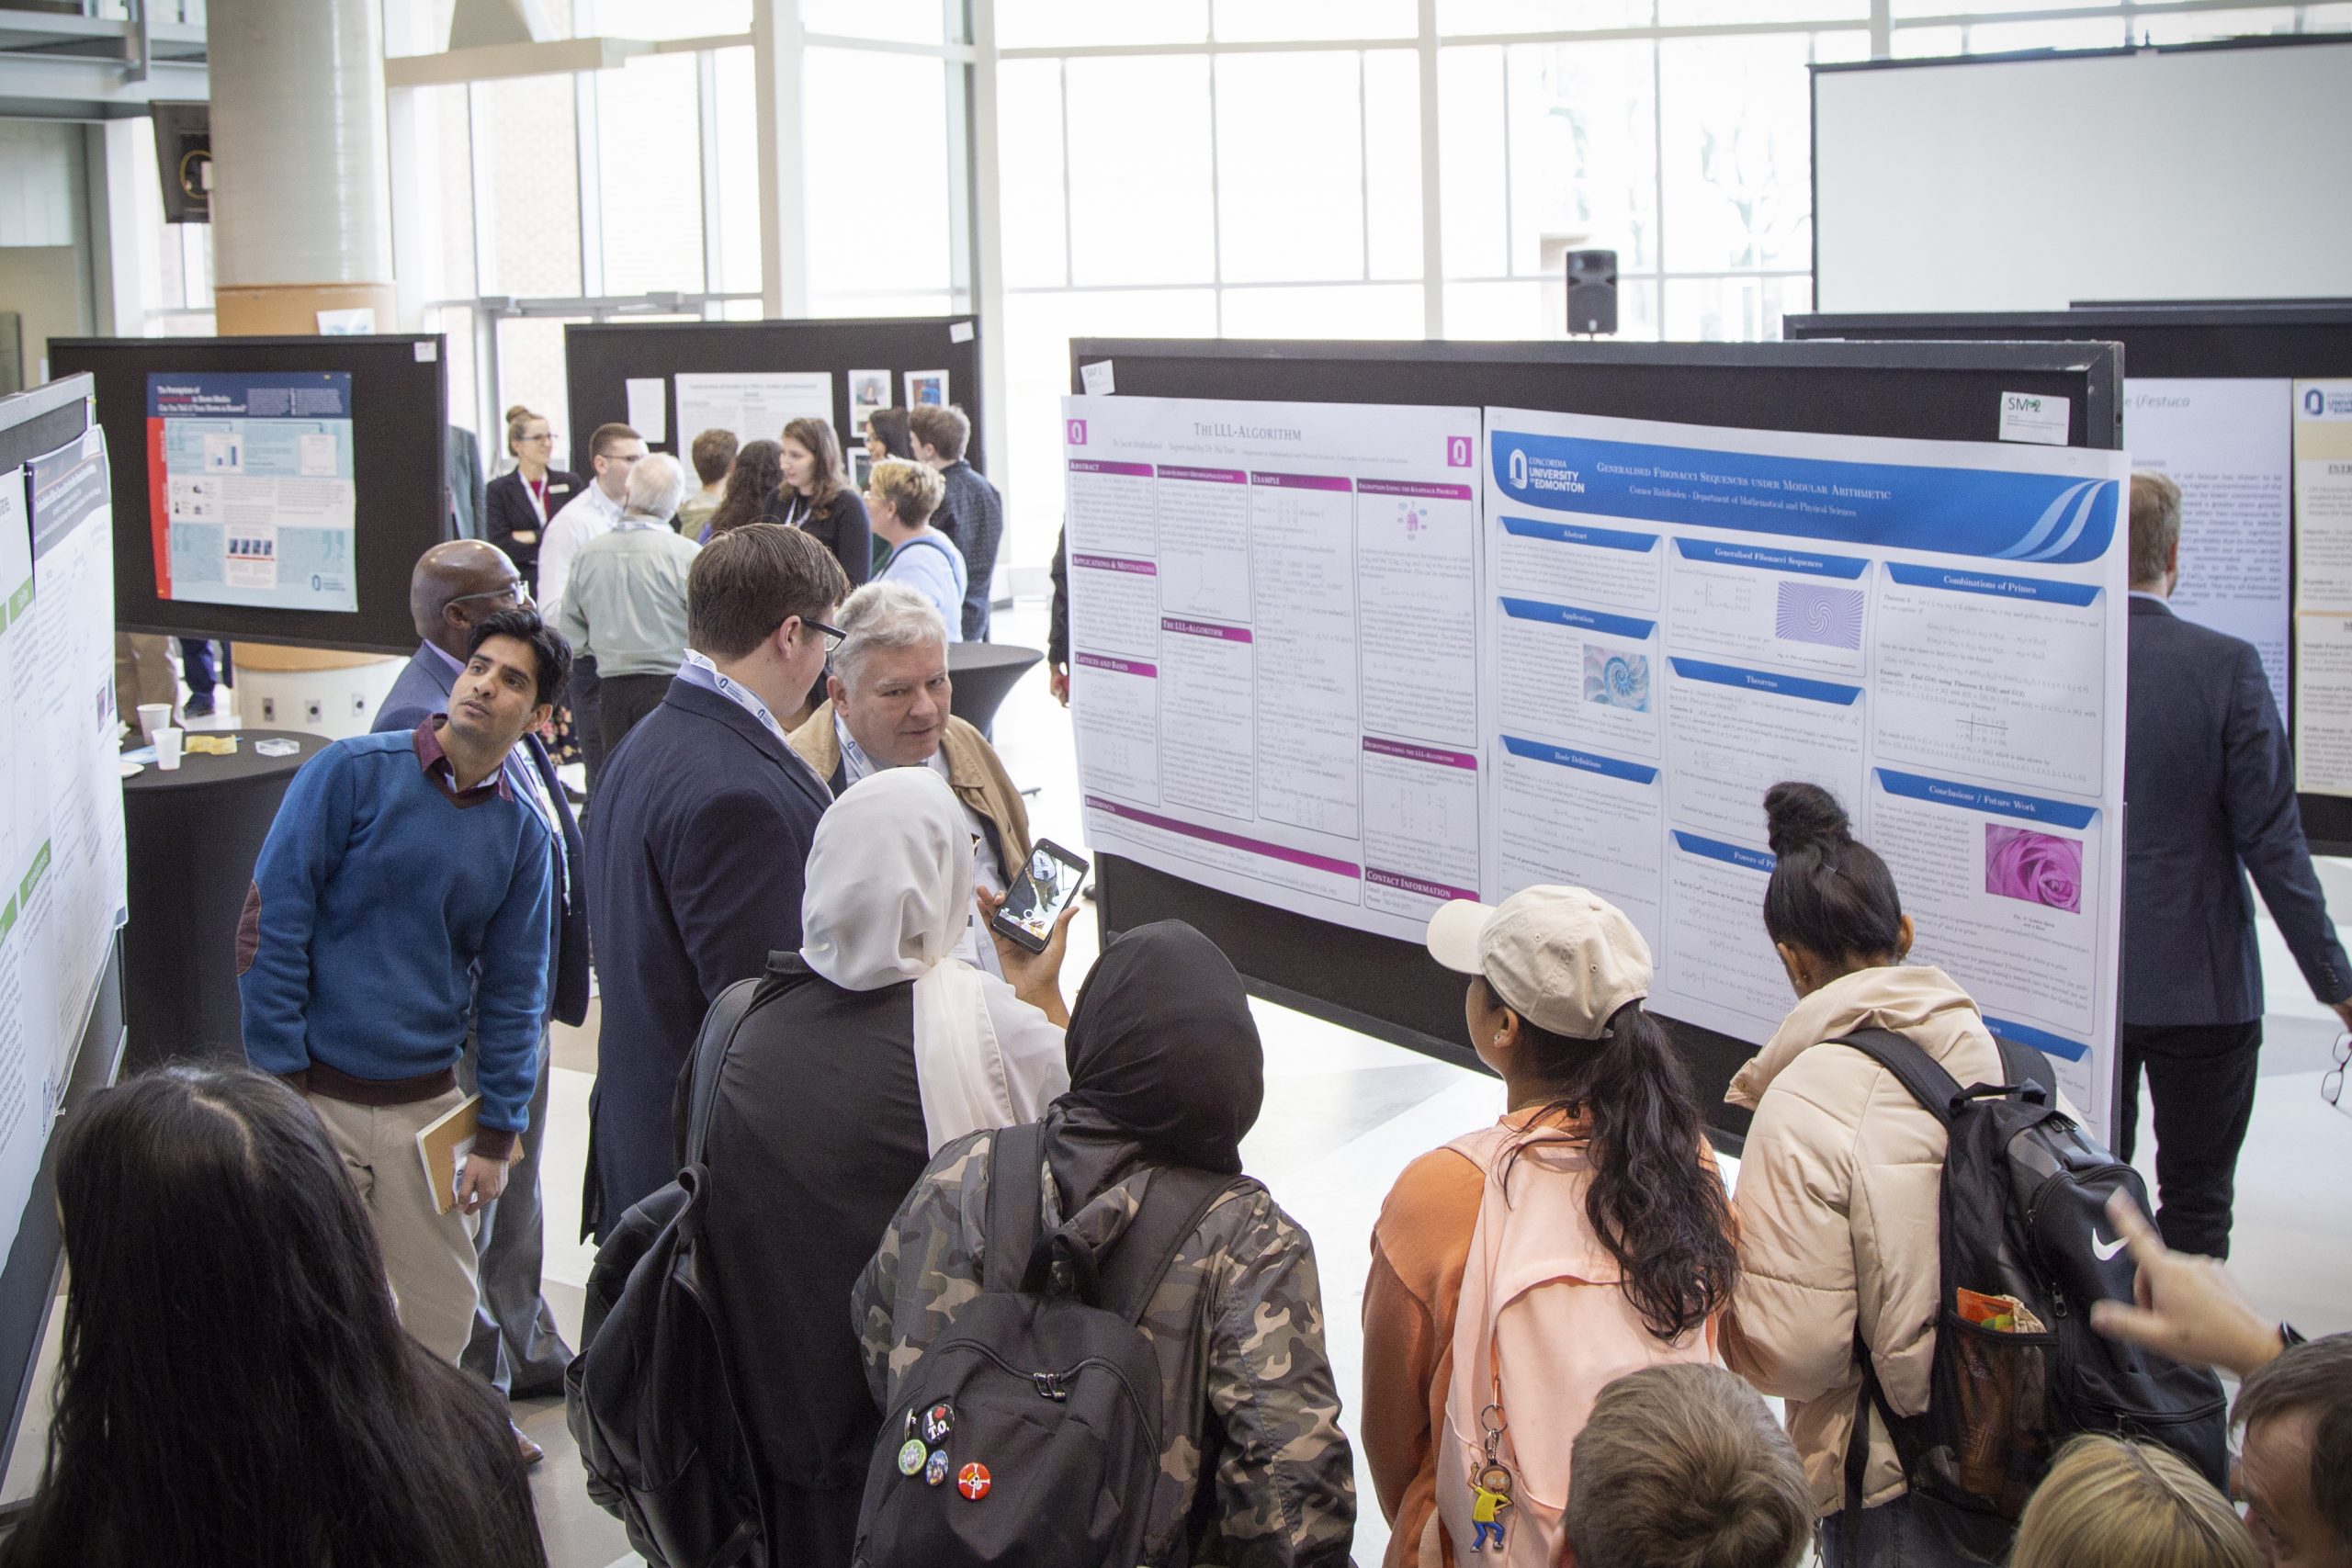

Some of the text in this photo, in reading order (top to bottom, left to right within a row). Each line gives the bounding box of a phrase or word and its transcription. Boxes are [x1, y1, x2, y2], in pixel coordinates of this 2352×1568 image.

[1253, 476, 1280, 485] EXAMPLE
[1529, 468, 1579, 481] UNIVERSITY
[1597, 463, 1891, 499] GENERALISED FIBONACCI SEQUENCES UNDER MODULAR ARITHMETIC
[1535, 480, 1585, 493] EDMONTON
[1715, 548, 1823, 570] Generalised Fibonacci Sequences
[1944, 576, 2036, 594] Combinations of Primes
[1929, 785, 1974, 802] Conclusions
[1984, 796, 2010, 808] Future
[2014, 801, 2036, 813] Work
[1367, 872, 1398, 886] CONTACT
[1401, 880, 1451, 898] INFORMATION
